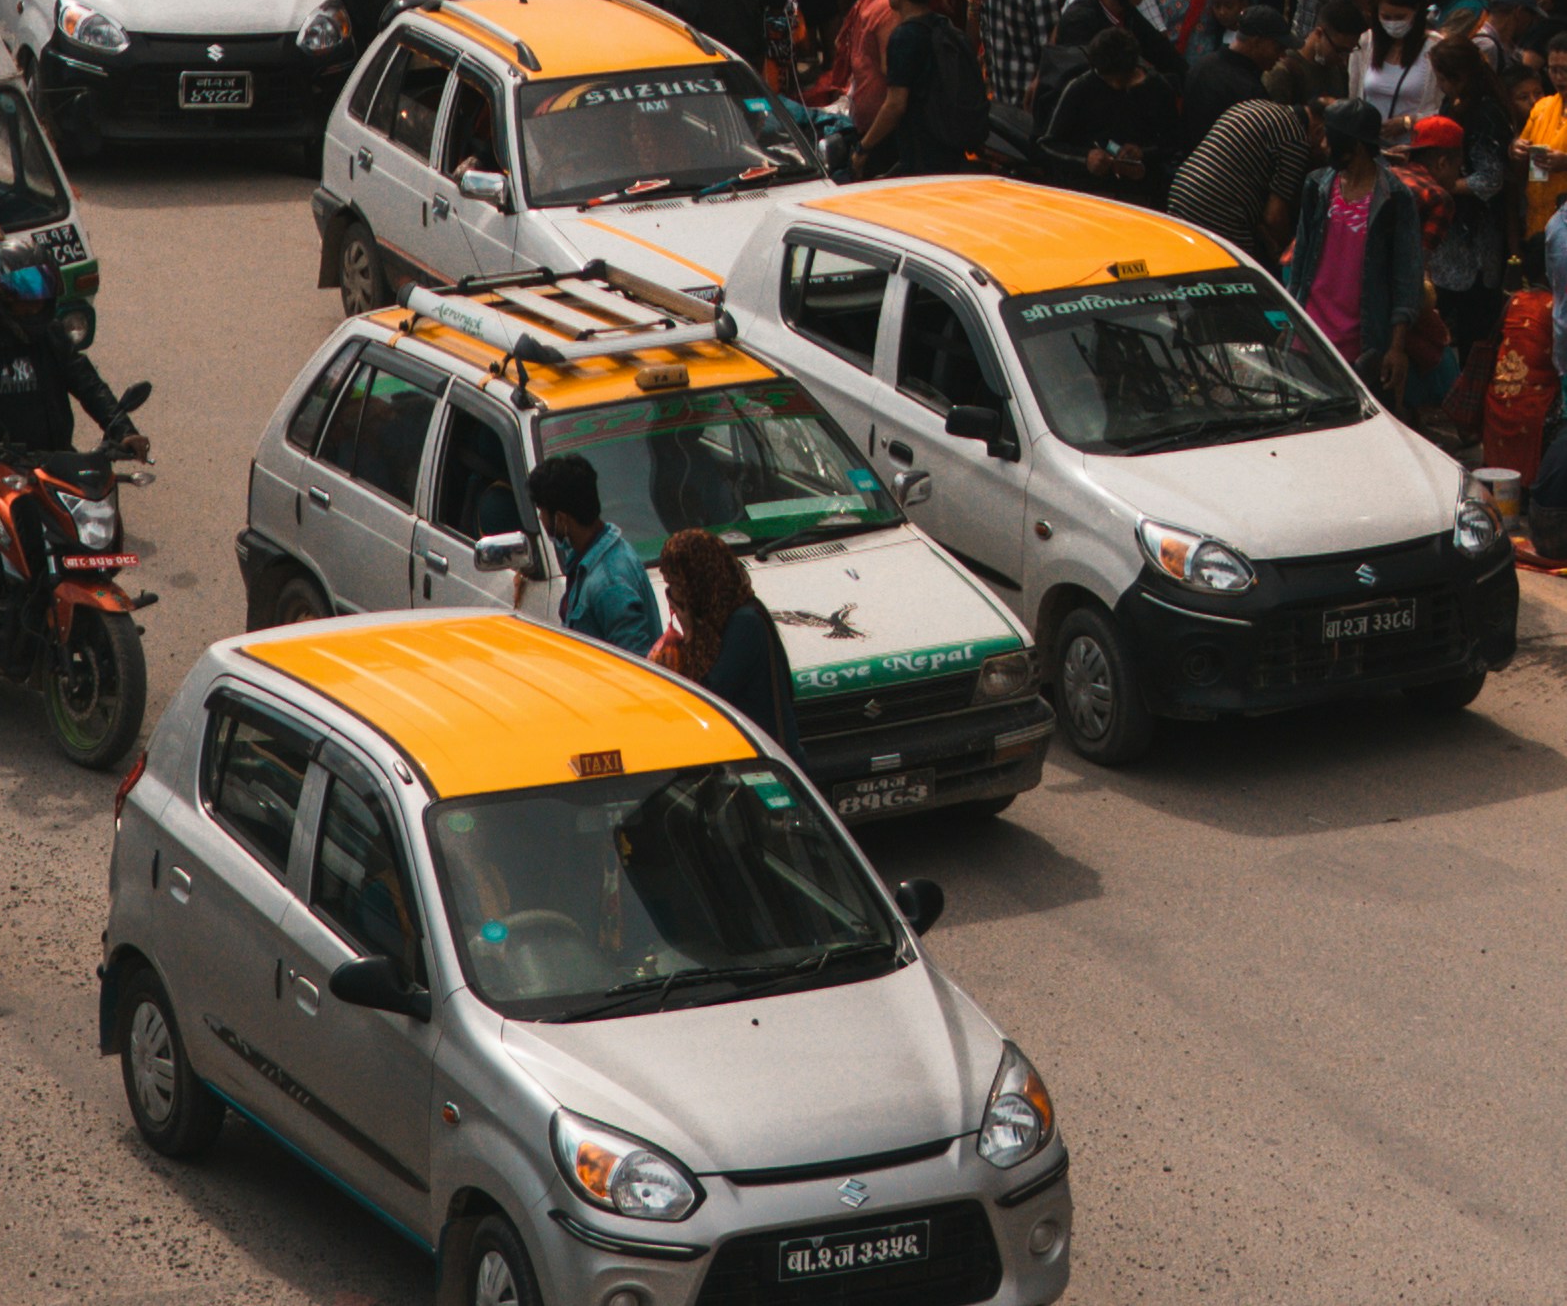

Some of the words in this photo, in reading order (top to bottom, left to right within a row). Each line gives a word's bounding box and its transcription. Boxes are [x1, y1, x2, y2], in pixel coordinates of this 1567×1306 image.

[584, 79, 728, 106] SUZUKI
[636, 99, 669, 113] TAXI
[1120, 262, 1146, 275] TAXI
[1021, 303, 1053, 324] श्री
[796, 664, 871, 689] Love
[883, 645, 974, 672] Nepal
[582, 754, 620, 773] TAXI
